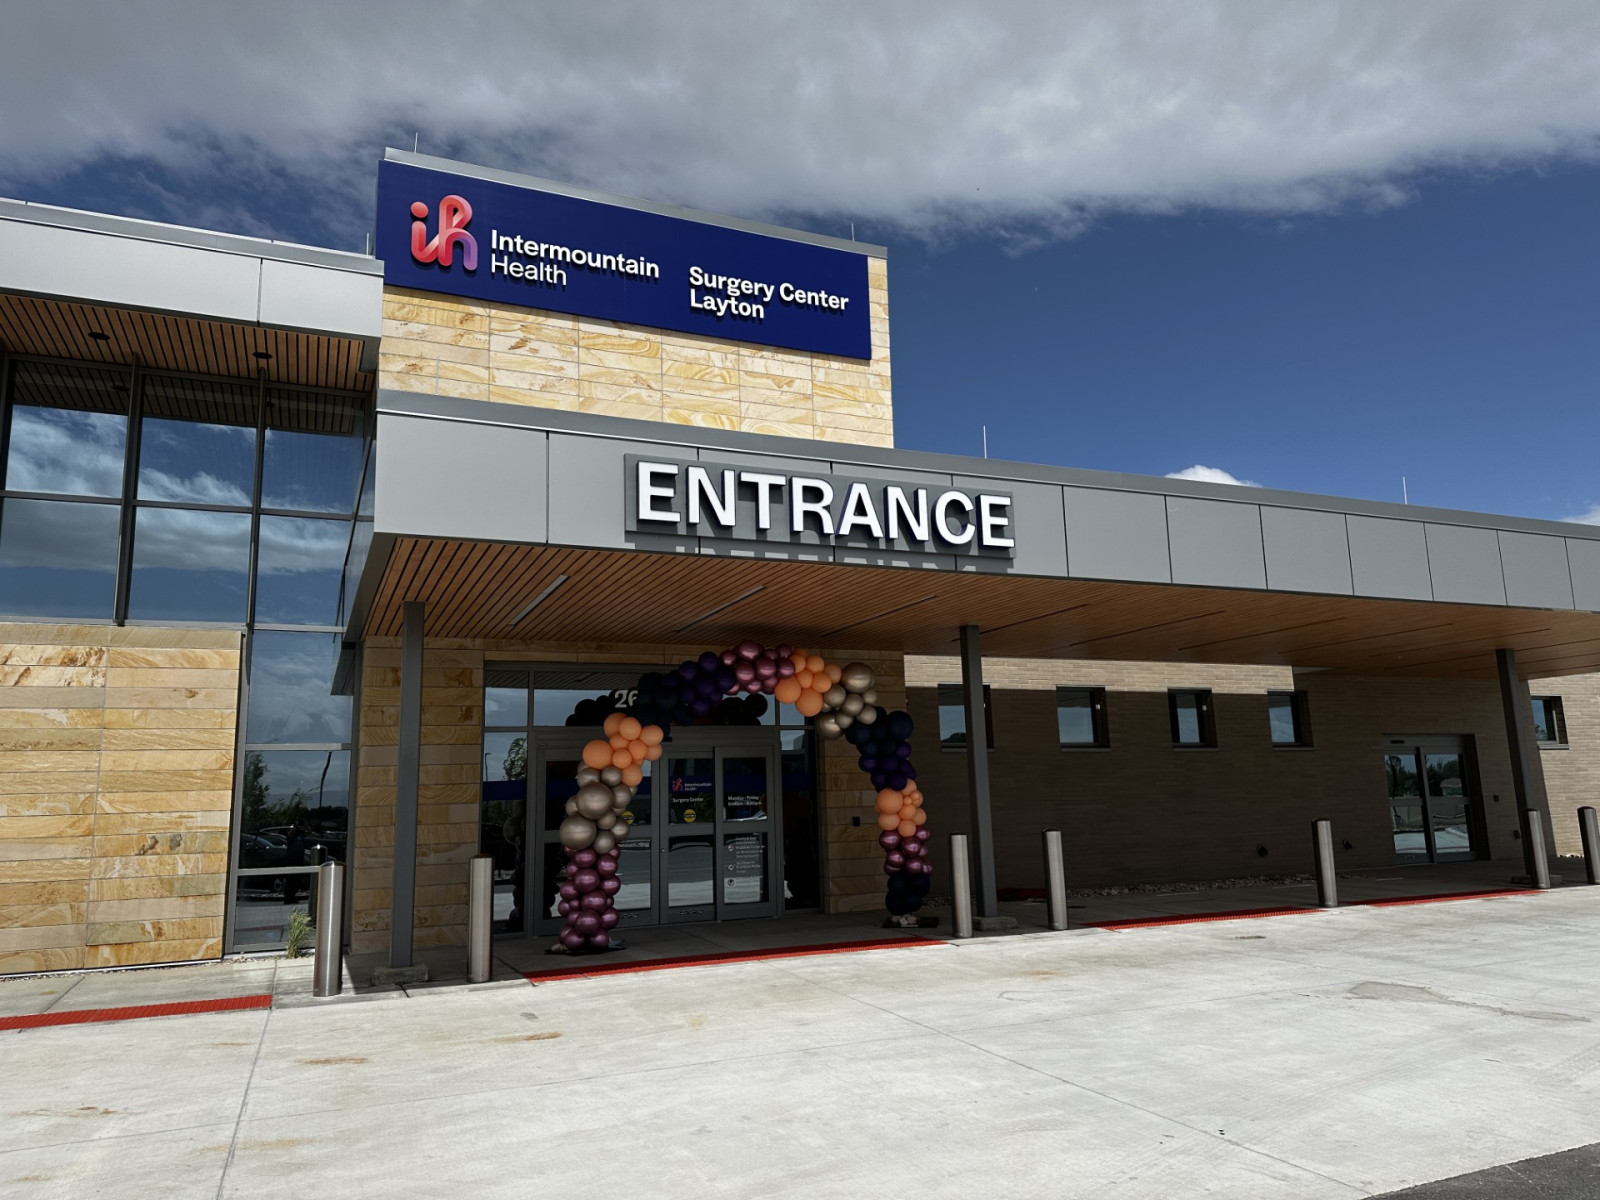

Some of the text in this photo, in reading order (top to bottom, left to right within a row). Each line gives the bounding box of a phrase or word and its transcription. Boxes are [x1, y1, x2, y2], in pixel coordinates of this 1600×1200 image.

[491, 229, 660, 279] Intermountain
[491, 255, 567, 286] Health
[688, 265, 849, 311] Surgery Center
[690, 288, 765, 320] Layton
[636, 460, 1015, 548] ENTRANCE
